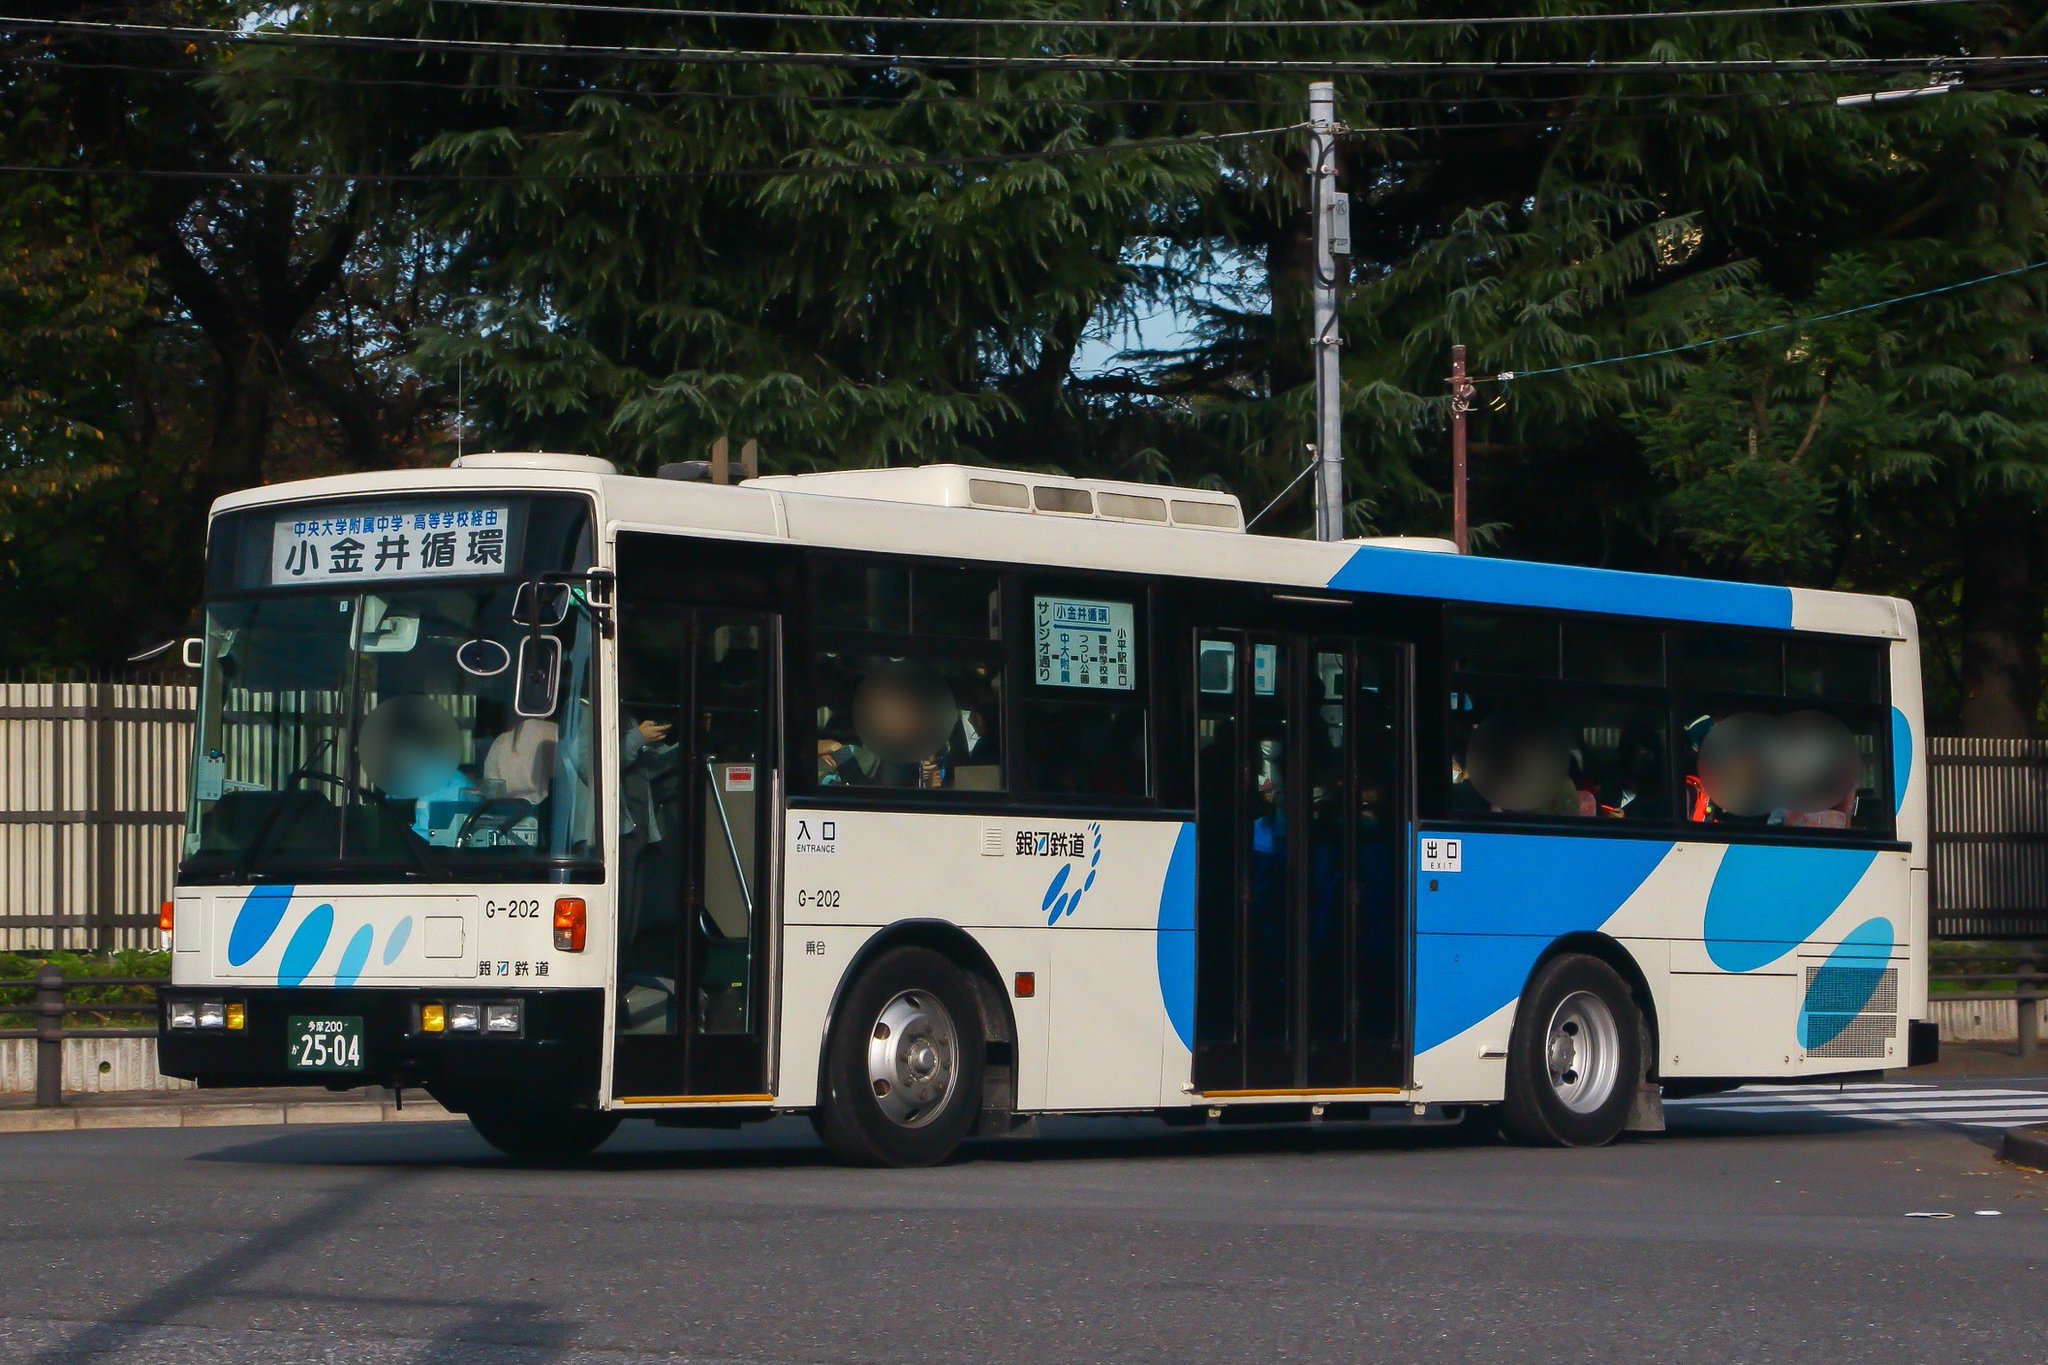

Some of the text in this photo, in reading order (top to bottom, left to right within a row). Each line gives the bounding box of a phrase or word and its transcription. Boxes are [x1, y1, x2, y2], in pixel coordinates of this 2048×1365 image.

[284, 528, 505, 576] 小金井循環
[1056, 605, 1108, 622] 小金井循環
[1037, 601, 1051, 682] サレジオ通り
[1060, 633, 1070, 683] 中大附属
[1079, 634, 1090, 684] つつじ公園
[1098, 634, 1108, 685] 警察学校東
[1116, 627, 1128, 686] 小平駅南口
[796, 820, 836, 841] 入口
[796, 844, 836, 854] ENTRANCE
[1015, 830, 1085, 858] 銀河鉄道
[1426, 840, 1457, 859] 出口
[1430, 861, 1453, 870] EXIT
[485, 899, 540, 919] G-202
[797, 889, 840, 908] G-202
[805, 940, 826, 956] 乗合
[478, 960, 550, 977] 銀河鉄道
[300, 1034, 360, 1067] 25-04
